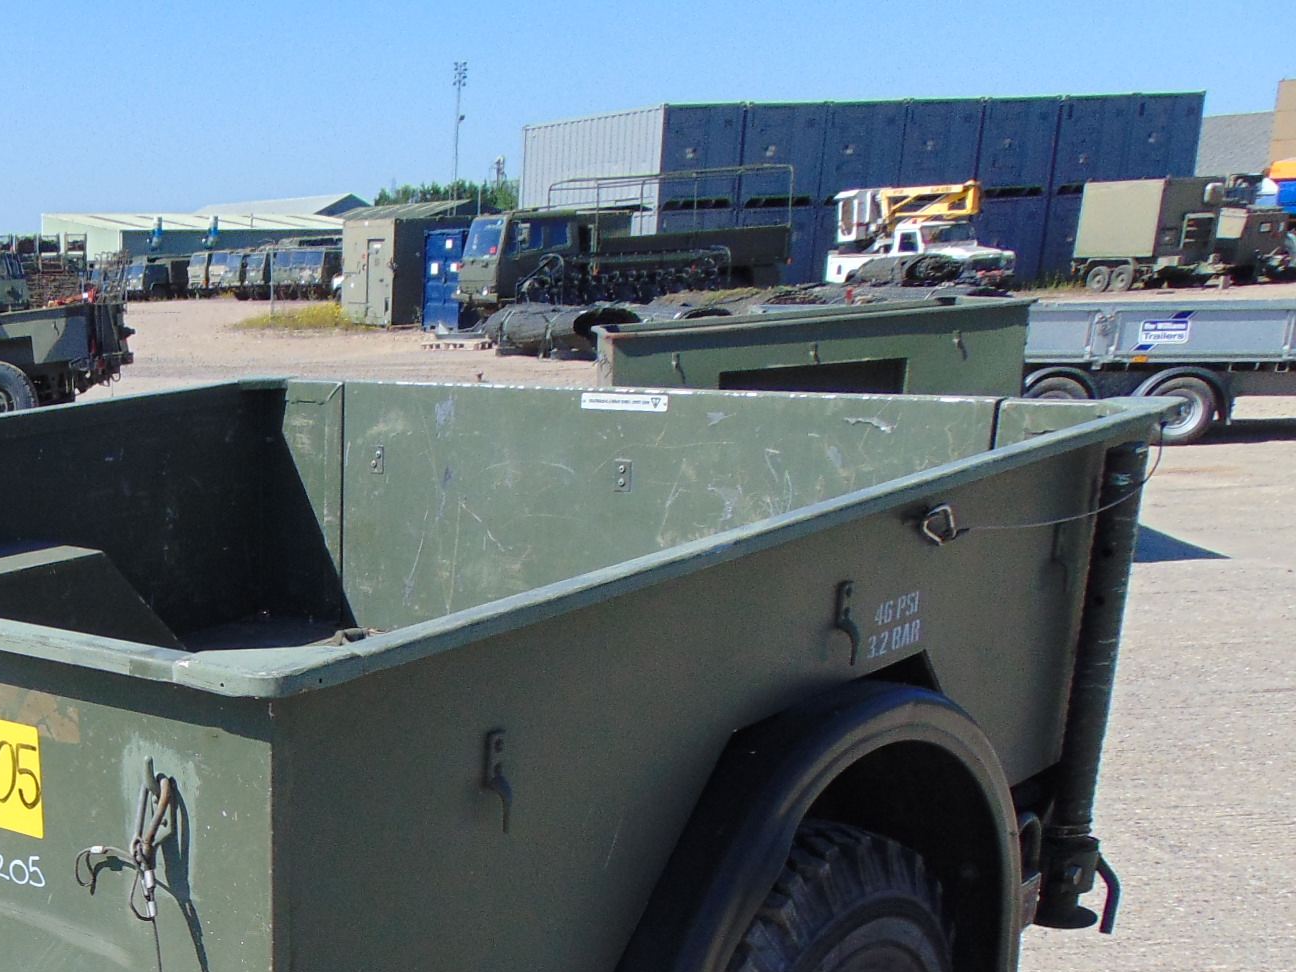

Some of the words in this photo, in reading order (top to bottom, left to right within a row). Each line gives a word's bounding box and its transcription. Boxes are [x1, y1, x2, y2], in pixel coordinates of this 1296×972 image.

[1144, 332, 1184, 340] Trailers
[874, 600, 894, 626] 46
[897, 591, 919, 619] PSI
[891, 619, 921, 650] BAR
